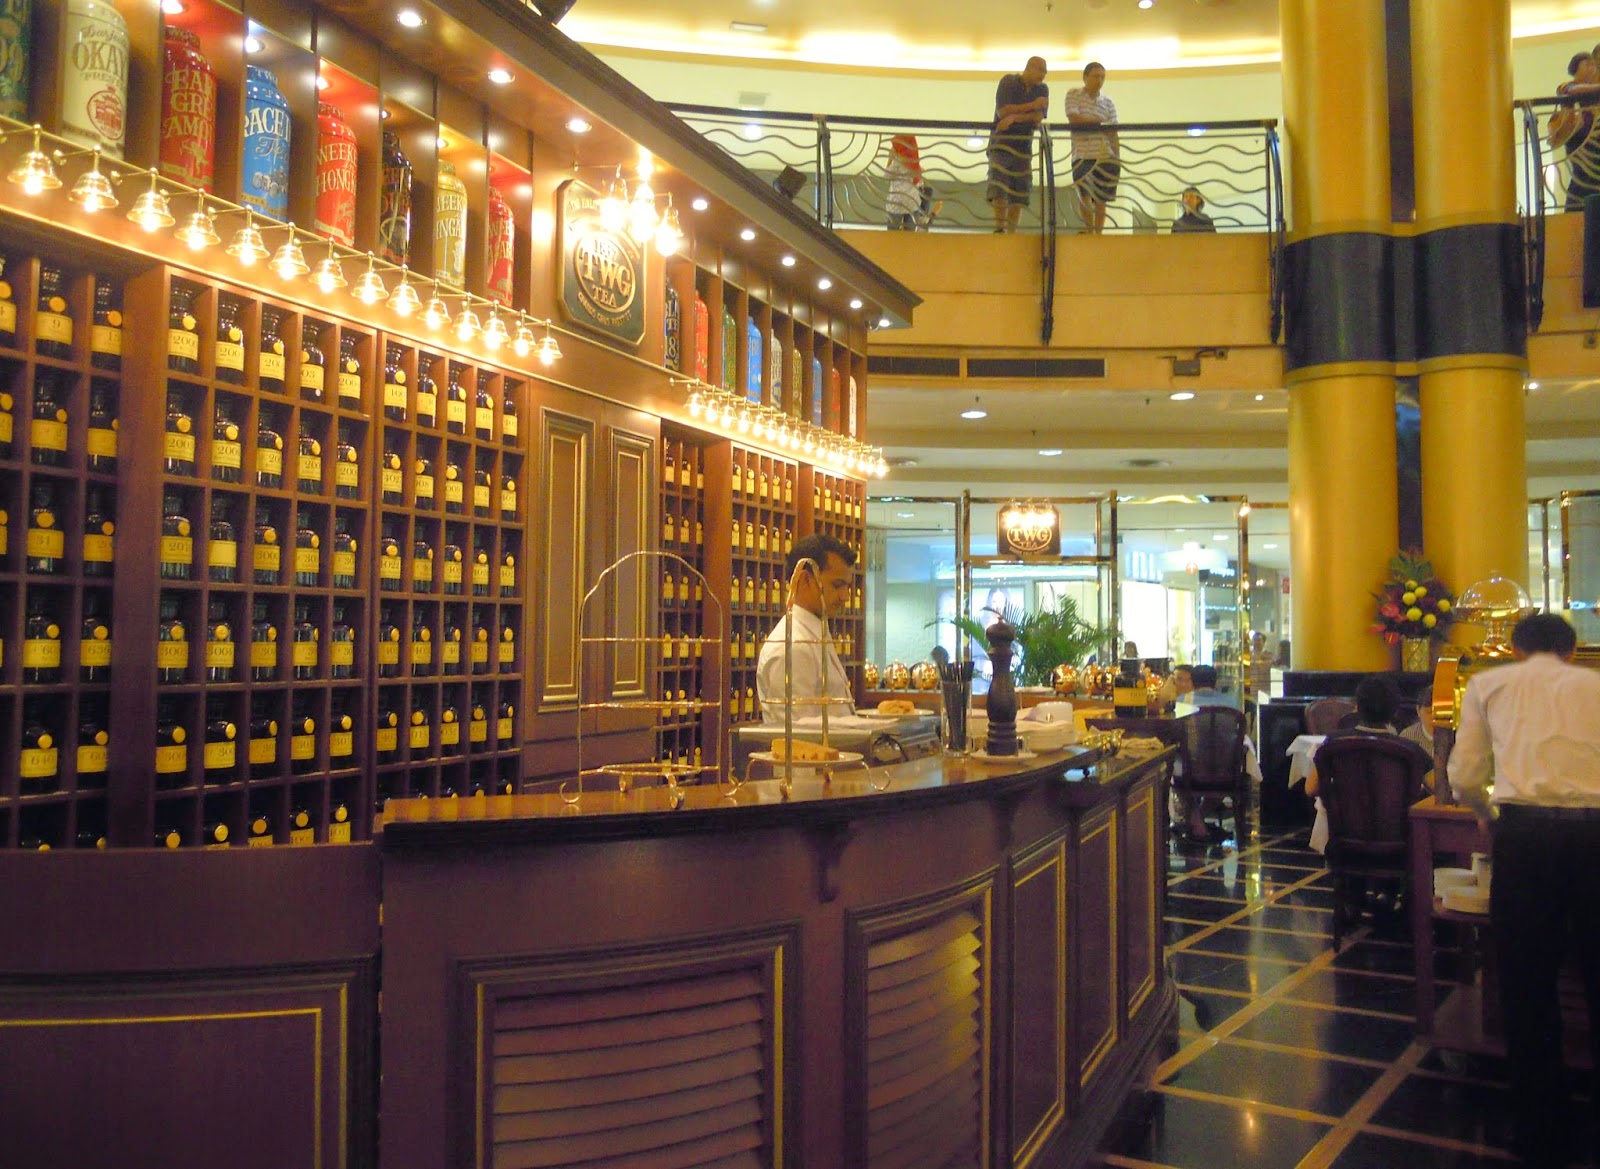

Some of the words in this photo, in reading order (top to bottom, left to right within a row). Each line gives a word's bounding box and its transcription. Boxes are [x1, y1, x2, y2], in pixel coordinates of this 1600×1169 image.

[579, 248, 631, 297] TWG
[592, 284, 617, 308] TEA
[1010, 528, 1049, 542] TWG
[1019, 541, 1038, 549] TEA
